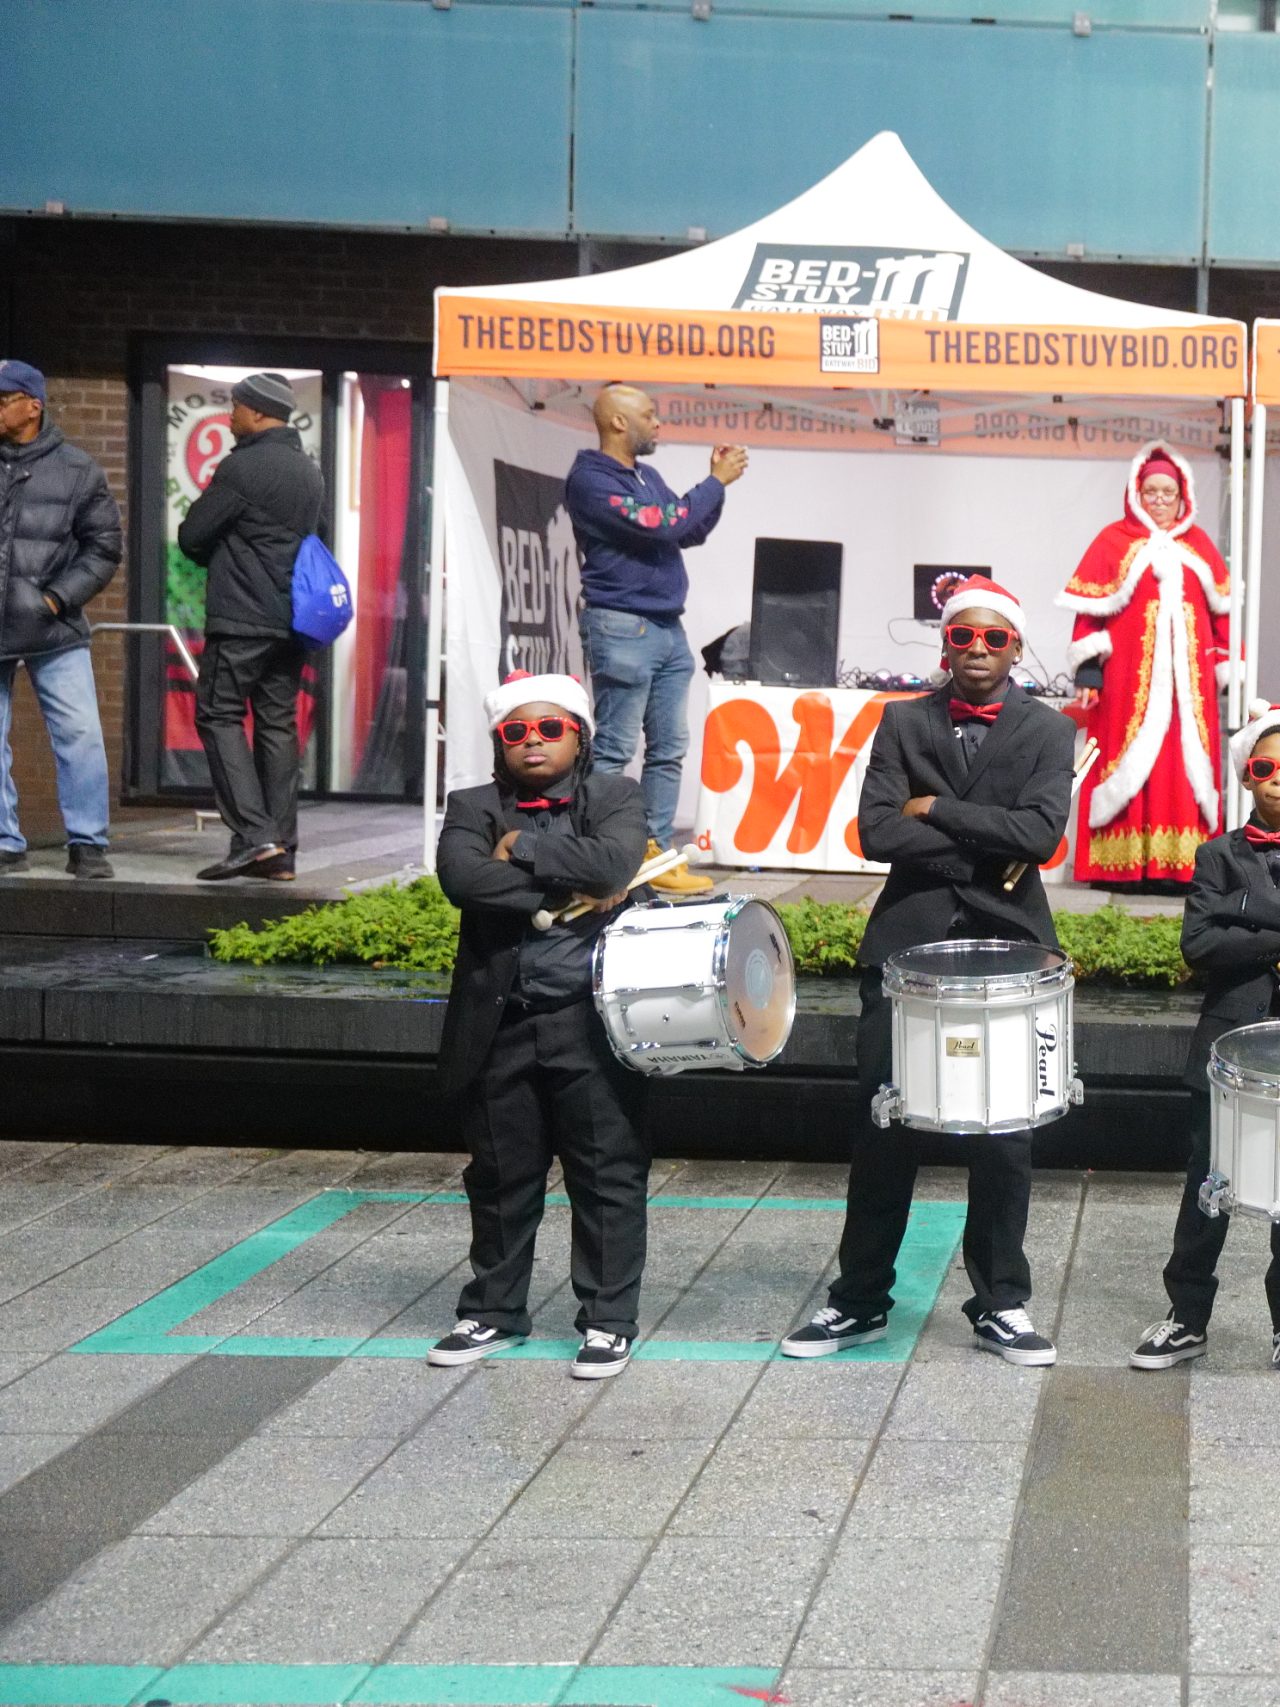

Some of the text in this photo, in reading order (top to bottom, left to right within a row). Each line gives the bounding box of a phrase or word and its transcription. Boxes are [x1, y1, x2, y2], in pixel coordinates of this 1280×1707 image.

[751, 284, 861, 304] STUY
[458, 313, 776, 358] THEBEDSTUYBID.ORG
[822, 341, 853, 356] STUY
[924, 330, 1238, 370] THEBEDSTUYBID.ORG
[168, 388, 313, 430] MOSD
[647, 1053, 709, 1064] YAMAHA
[1034, 1016, 1058, 1097] Pearl
